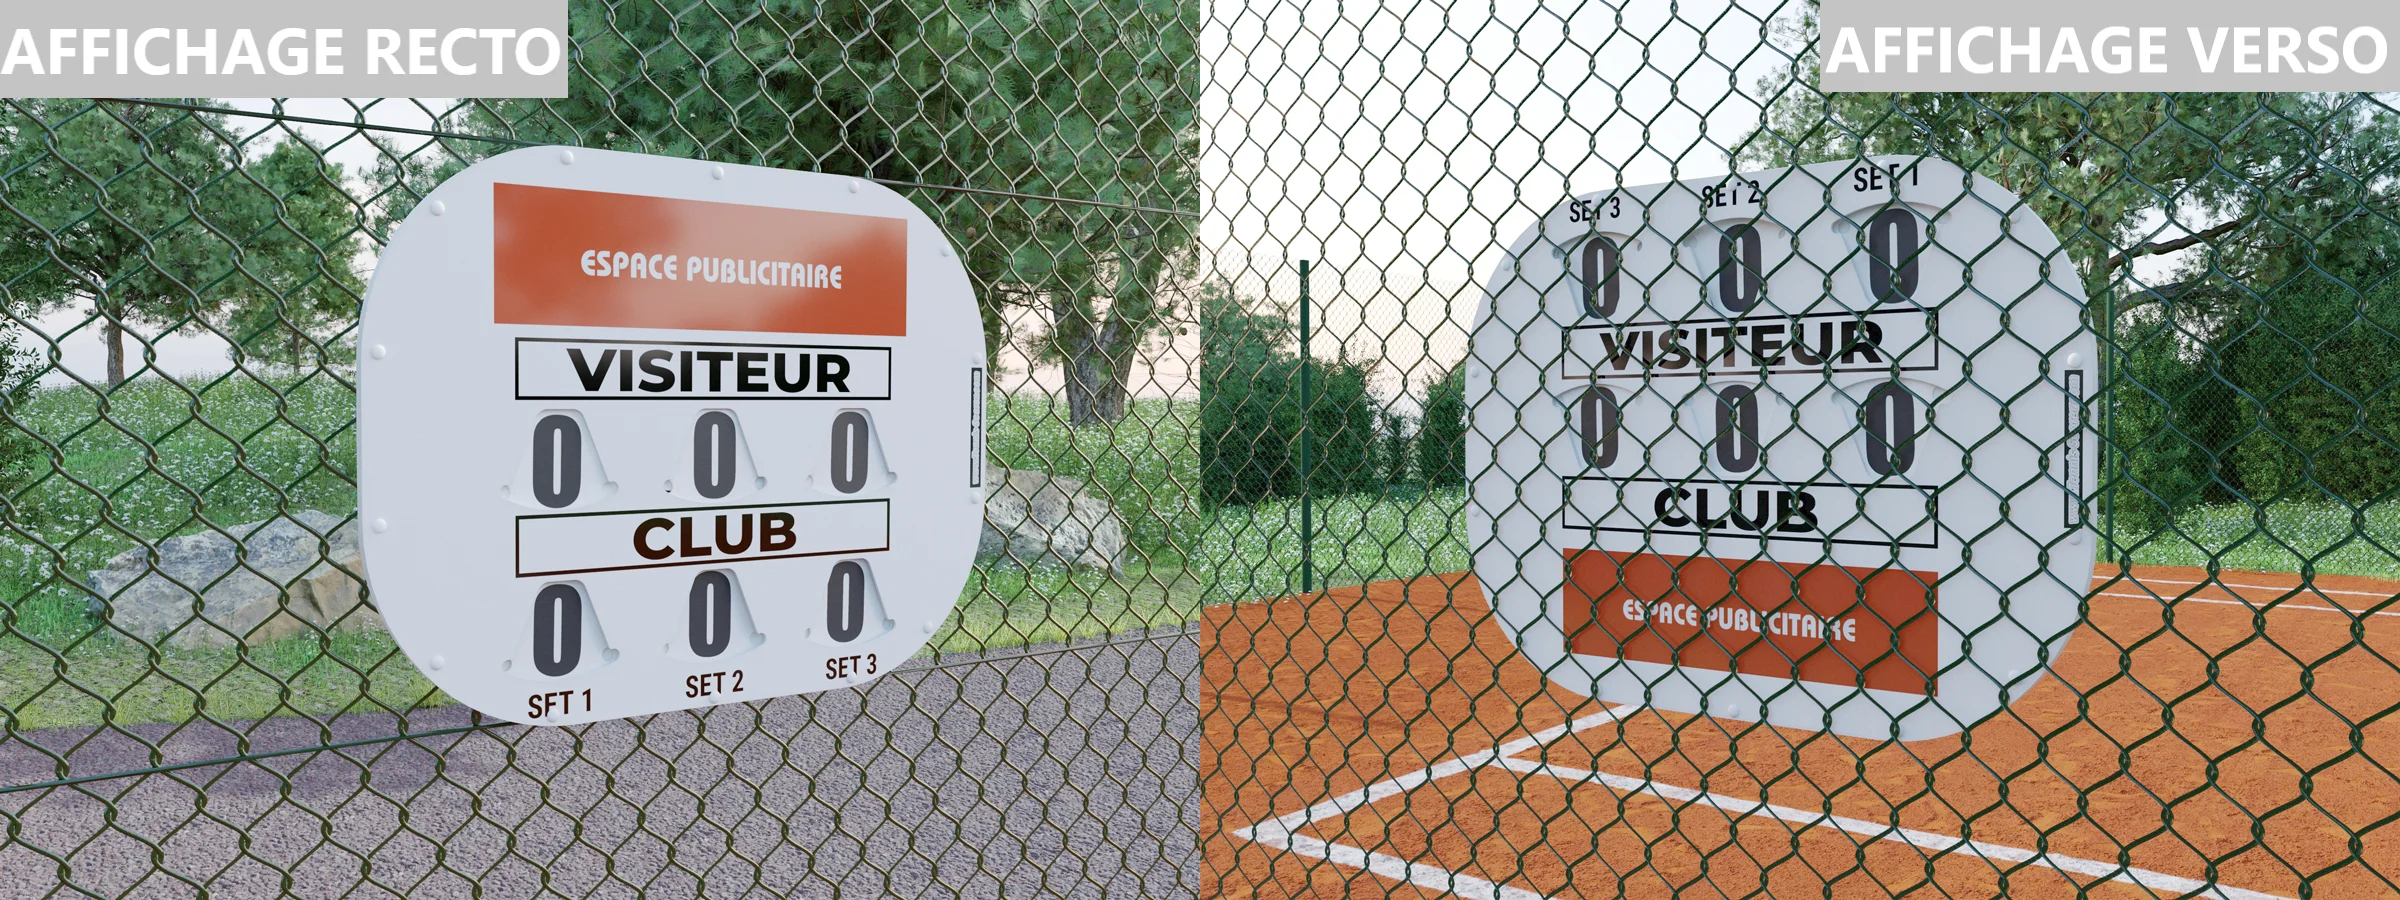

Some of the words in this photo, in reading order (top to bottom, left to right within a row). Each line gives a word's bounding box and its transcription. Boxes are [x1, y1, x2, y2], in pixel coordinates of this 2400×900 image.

[1610, 197, 1620, 218] 3
[1702, 182, 1741, 208] SET
[1748, 180, 1760, 204] 2
[581, 250, 678, 281] ESPACE
[687, 256, 842, 290] PUBLICITAIRE
[1581, 236, 1620, 320] 0
[1718, 223, 1762, 313] 0
[1869, 208, 1919, 304] 0
[1599, 320, 1884, 371] VISITEUR
[566, 348, 851, 393] VISITEUR
[1580, 385, 1619, 469] 0
[1715, 384, 1759, 473] 0
[1865, 381, 1915, 477] 0
[532, 414, 582, 509] 0
[693, 411, 737, 499] 0
[830, 411, 869, 494] 0
[1654, 487, 1818, 533] CLUB
[633, 512, 797, 561] CLUB
[533, 583, 582, 678] 0
[688, 569, 732, 658] 0
[826, 560, 865, 643] 0
[1622, 599, 1697, 627] ESPACE
[1706, 606, 1856, 643] PUBLICITAIRE
[685, 671, 726, 699] SET
[732, 669, 744, 693] 2
[825, 655, 861, 680] SET
[866, 653, 877, 676] 3
[527, 690, 574, 719] SET
[582, 688, 592, 712] 1
